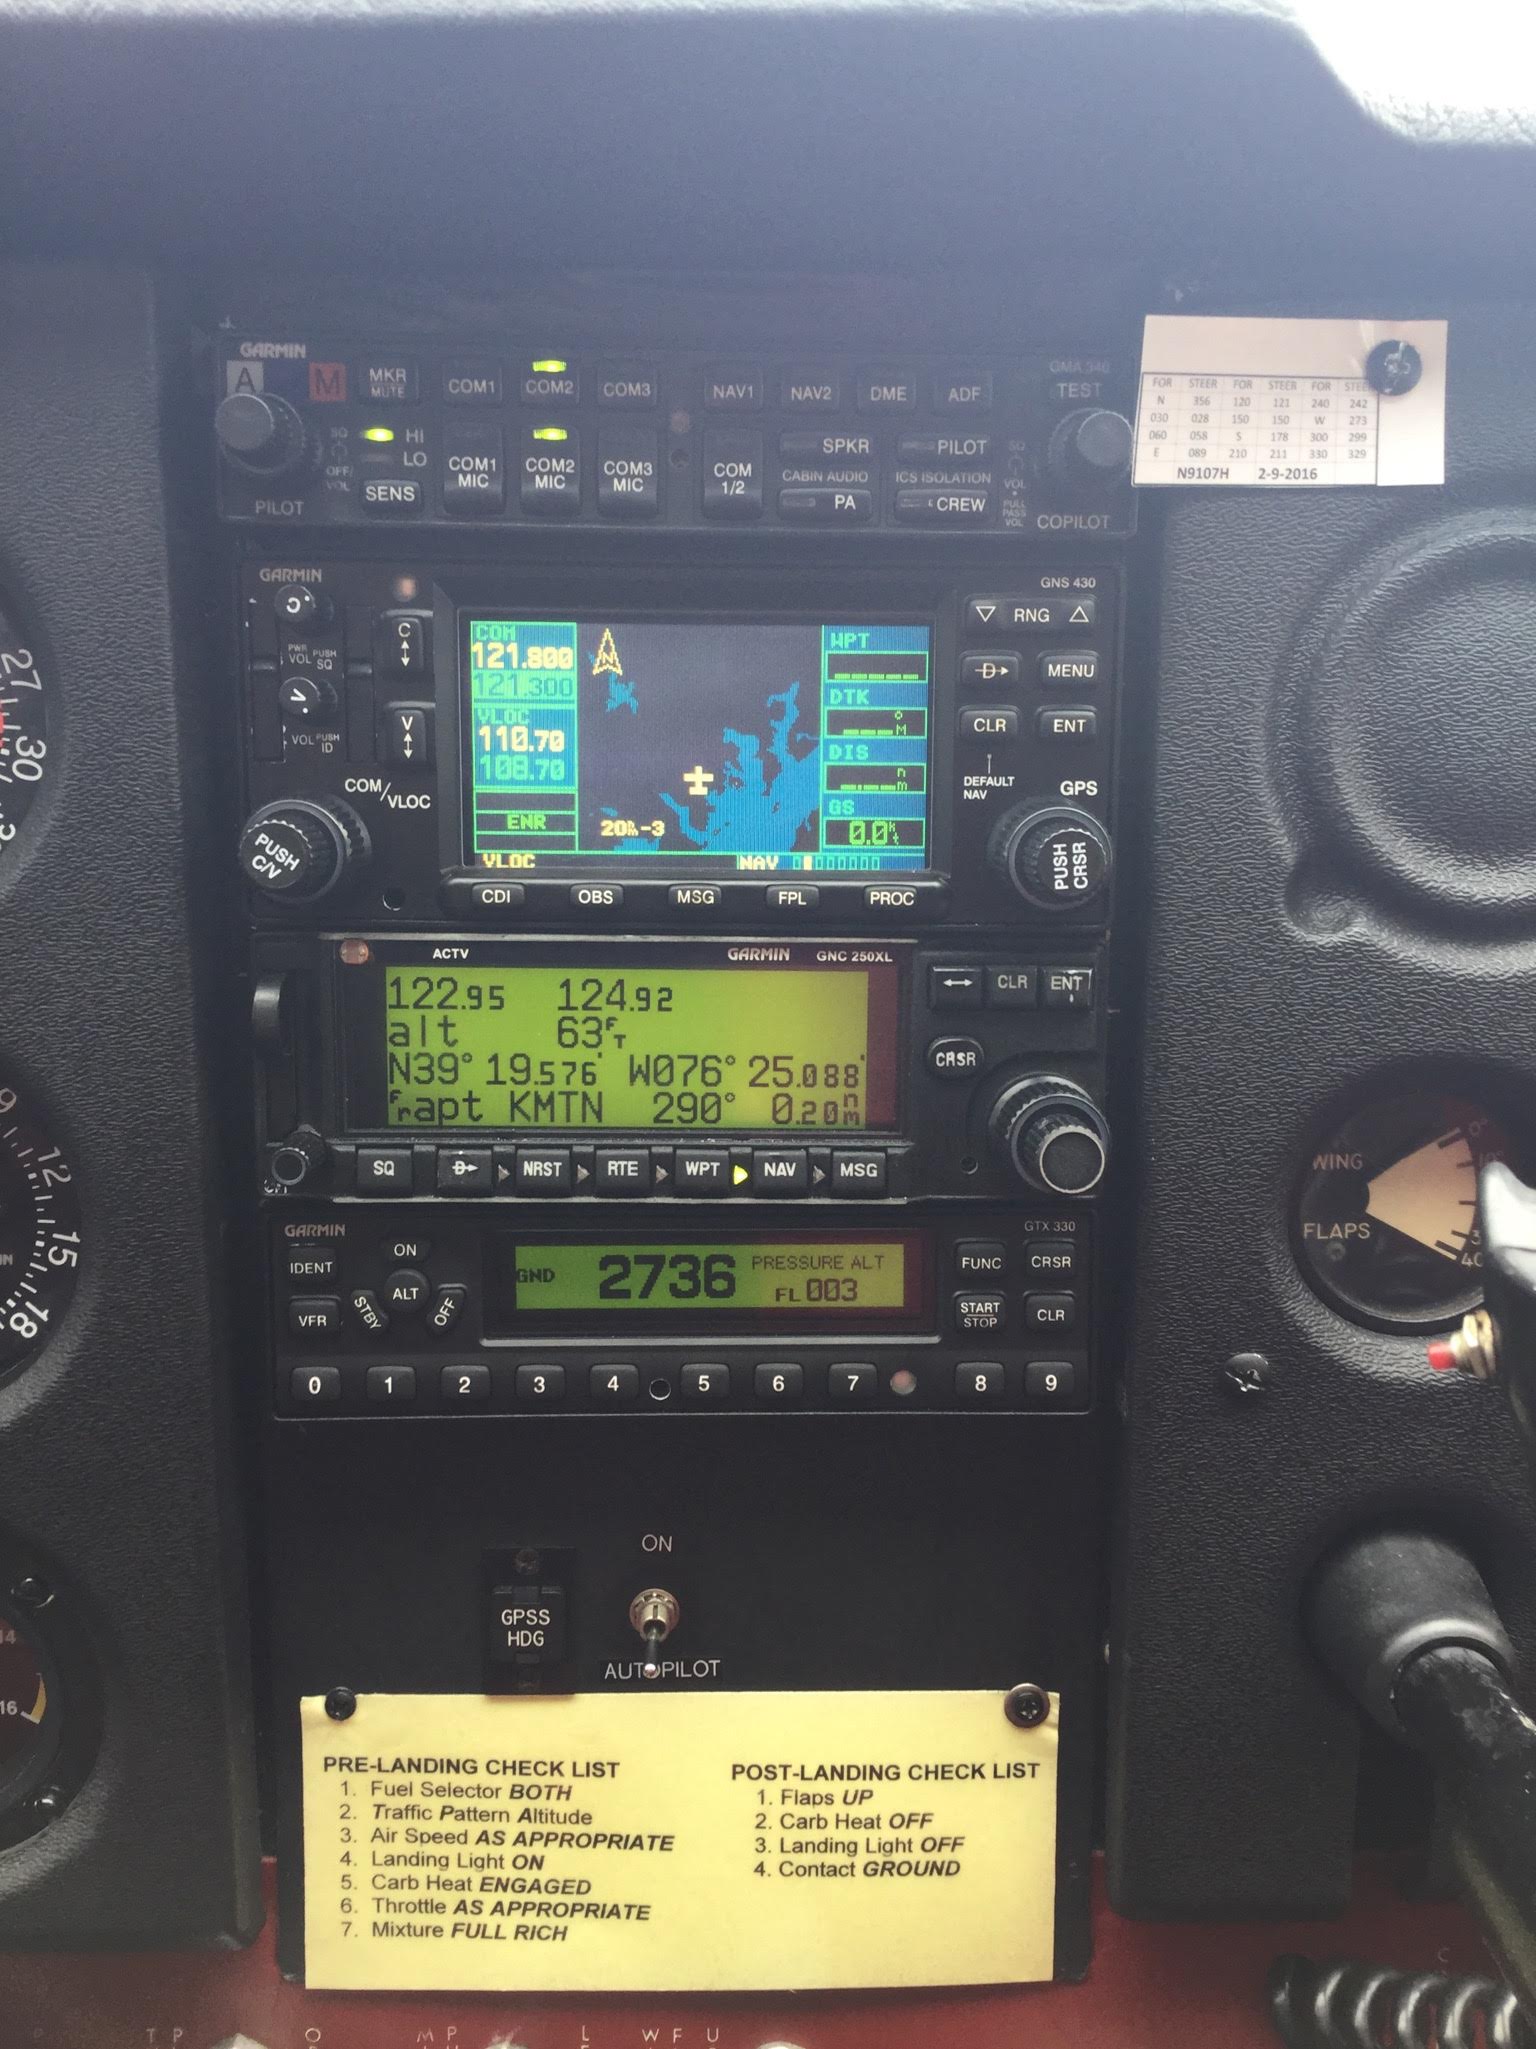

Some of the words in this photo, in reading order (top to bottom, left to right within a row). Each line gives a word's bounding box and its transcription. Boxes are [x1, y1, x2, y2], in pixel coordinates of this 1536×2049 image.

[369, 368, 406, 382] MKR
[449, 379, 495, 393] COM1
[526, 381, 573, 394] COM2
[604, 383, 650, 397] COM3
[1057, 383, 1101, 397] TEST
[1153, 377, 1172, 387] FOR
[1189, 379, 1217, 388] STEER
[1234, 380, 1253, 389] FOR
[1268, 380, 1297, 390] STEER
[1312, 381, 1331, 391] FOR
[371, 385, 405, 398] MUTE
[713, 385, 753, 399] NAV1
[791, 387, 831, 400] NAV2
[870, 387, 907, 400] DME
[948, 387, 980, 401] ADF
[1350, 399, 1367, 408] 242
[1151, 413, 1168, 422] 030
[1232, 414, 1249, 424] 150
[1272, 415, 1289, 425] 150
[1349, 416, 1367, 425] 273
[405, 430, 424, 443] HI
[1149, 430, 1167, 440] 060
[1271, 432, 1288, 442] 178
[1310, 432, 1328, 442] 300
[1349, 433, 1367, 442] 299
[823, 439, 869, 454] SPKR
[938, 440, 986, 455] PILOT
[404, 453, 427, 467] LO
[1229, 449, 1247, 459] 210
[1270, 449, 1287, 459] 211
[1348, 450, 1366, 459] 329
[449, 457, 496, 472] COM1
[526, 458, 574, 473] COM2
[604, 461, 652, 475] COM3
[714, 463, 752, 478] COM
[459, 474, 489, 488] MIC
[782, 470, 822, 482] CABIN
[825, 470, 868, 483] AUDIO
[896, 471, 917, 483] ICS
[922, 472, 991, 484] ISOLATION
[1177, 468, 1229, 479] N9107H
[1258, 468, 1317, 480] 2-9-2016
[535, 475, 566, 489] MIC
[613, 477, 643, 492] MIC
[722, 481, 745, 495] 1/2
[366, 486, 415, 501] SENS
[255, 501, 304, 515] PILOT
[834, 496, 855, 510] PA
[936, 497, 986, 512] CREW
[1037, 515, 1109, 529] COPILOT
[259, 569, 322, 582] GARMIN
[1041, 578, 1069, 588] GNS
[1073, 578, 1096, 588] 430
[1014, 609, 1049, 622] RNG
[476, 625, 516, 640] COM
[831, 633, 870, 648] WPT
[472, 642, 573, 669] 121.800
[1, 649, 42, 690] 27
[1048, 664, 1094, 677] MENU
[473, 674, 573, 697] 121.300
[830, 689, 869, 704] DTK
[477, 709, 529, 724] VLOC
[974, 718, 1005, 732] CLR
[1054, 719, 1086, 732] ENT
[479, 726, 564, 752] 110.70
[12, 736, 46, 781] 30
[829, 745, 868, 759] DIS
[964, 776, 1014, 786] DEFAULT
[1060, 781, 1097, 795] GPS
[964, 790, 987, 799] NAV
[387, 795, 431, 809] VLOC
[507, 815, 546, 829] ENR
[251, 855, 282, 879] C/V
[1053, 844, 1068, 890] PUSH
[1072, 842, 1088, 889] CRSR
[482, 889, 510, 903] CDI
[579, 890, 613, 904] OBS
[678, 890, 714, 904] MSG
[778, 891, 805, 905] FPL
[870, 891, 913, 906] PROC
[433, 949, 469, 959] ACTV
[727, 947, 790, 961] GARMIN
[816, 951, 847, 961] GNC
[852, 951, 892, 962] 250XL
[998, 975, 1027, 989] CLR
[1051, 976, 1082, 990] ENT
[388, 976, 504, 1010] 122.95
[558, 978, 673, 1012] 124.92
[388, 1015, 458, 1047] alt
[936, 1051, 976, 1066] CRSR
[510, 1091, 602, 1122] KMTN
[374, 1161, 394, 1176] SQ
[523, 1161, 562, 1176] NRST
[608, 1161, 638, 1175] RTE
[686, 1162, 720, 1176] WPT
[1313, 1154, 1362, 1170] WING
[764, 1163, 796, 1176] NAV
[840, 1164, 877, 1177] MSG
[285, 1224, 345, 1237] GARMIN
[1025, 1221, 1049, 1231] GTX
[1304, 1223, 1370, 1239] FLAPS
[48, 1232, 80, 1267] 15
[394, 1244, 416, 1256] ON
[290, 1262, 332, 1274] IDENT
[752, 1256, 843, 1269] PRESSURE
[851, 1256, 884, 1268] ALT
[962, 1257, 1001, 1269] FUNC
[1032, 1256, 1071, 1268] CRSR
[516, 1268, 555, 1283] GND
[600, 1254, 736, 1299] 2736
[393, 1288, 419, 1300] ALT
[961, 1303, 1000, 1313] START
[1037, 1309, 1065, 1321] CLR
[10, 1302, 49, 1338] 18
[299, 1315, 326, 1326] VFR
[964, 1318, 997, 1328] STOP
[642, 1534, 672, 1552] ON
[502, 1610, 550, 1625] GPSS
[508, 1631, 544, 1646] HDG
[324, 1757, 478, 1774] PRE-LANDING
[485, 1760, 565, 1776] CHECK
[572, 1761, 620, 1778] LIST
[732, 1764, 901, 1781] POST-LANDING
[908, 1764, 986, 1780] CHECK
[992, 1763, 1040, 1779] LIST
[371, 1781, 413, 1797] Fuel
[421, 1782, 502, 1798] Selector
[509, 1784, 572, 1800] BOTH
[781, 1789, 834, 1809] Flaps
[842, 1789, 873, 1805] UP
[372, 1804, 432, 1820] Traffic
[439, 1805, 510, 1823] Pattern
[517, 1808, 592, 1825] Altitude
[780, 1813, 828, 1829] Carb
[835, 1813, 881, 1829] Heat
[889, 1813, 933, 1829] OFF
[371, 1828, 398, 1844] Air
[405, 1829, 468, 1849] Speed
[475, 1831, 506, 1846] AS
[513, 1832, 674, 1851] APPROPRIATE
[780, 1838, 858, 1858] Landing
[865, 1837, 913, 1857] Light
[920, 1837, 965, 1852] OFF
[372, 1851, 449, 1870] Landing
[458, 1853, 505, 1872] Light
[512, 1854, 544, 1870] ON
[779, 1861, 855, 1878] Contact
[862, 1861, 960, 1877] GROUND
[372, 1874, 419, 1890] Carb
[426, 1875, 472, 1892] Heat
[479, 1878, 592, 1895] ENGAGED
[372, 1898, 446, 1915] Throttle
[453, 1900, 483, 1915] AS
[490, 1900, 651, 1920] APPROPRIATE
[372, 1922, 443, 1939] Mixture
[451, 1923, 507, 1940] FULL
[514, 1925, 568, 1941] RICH
